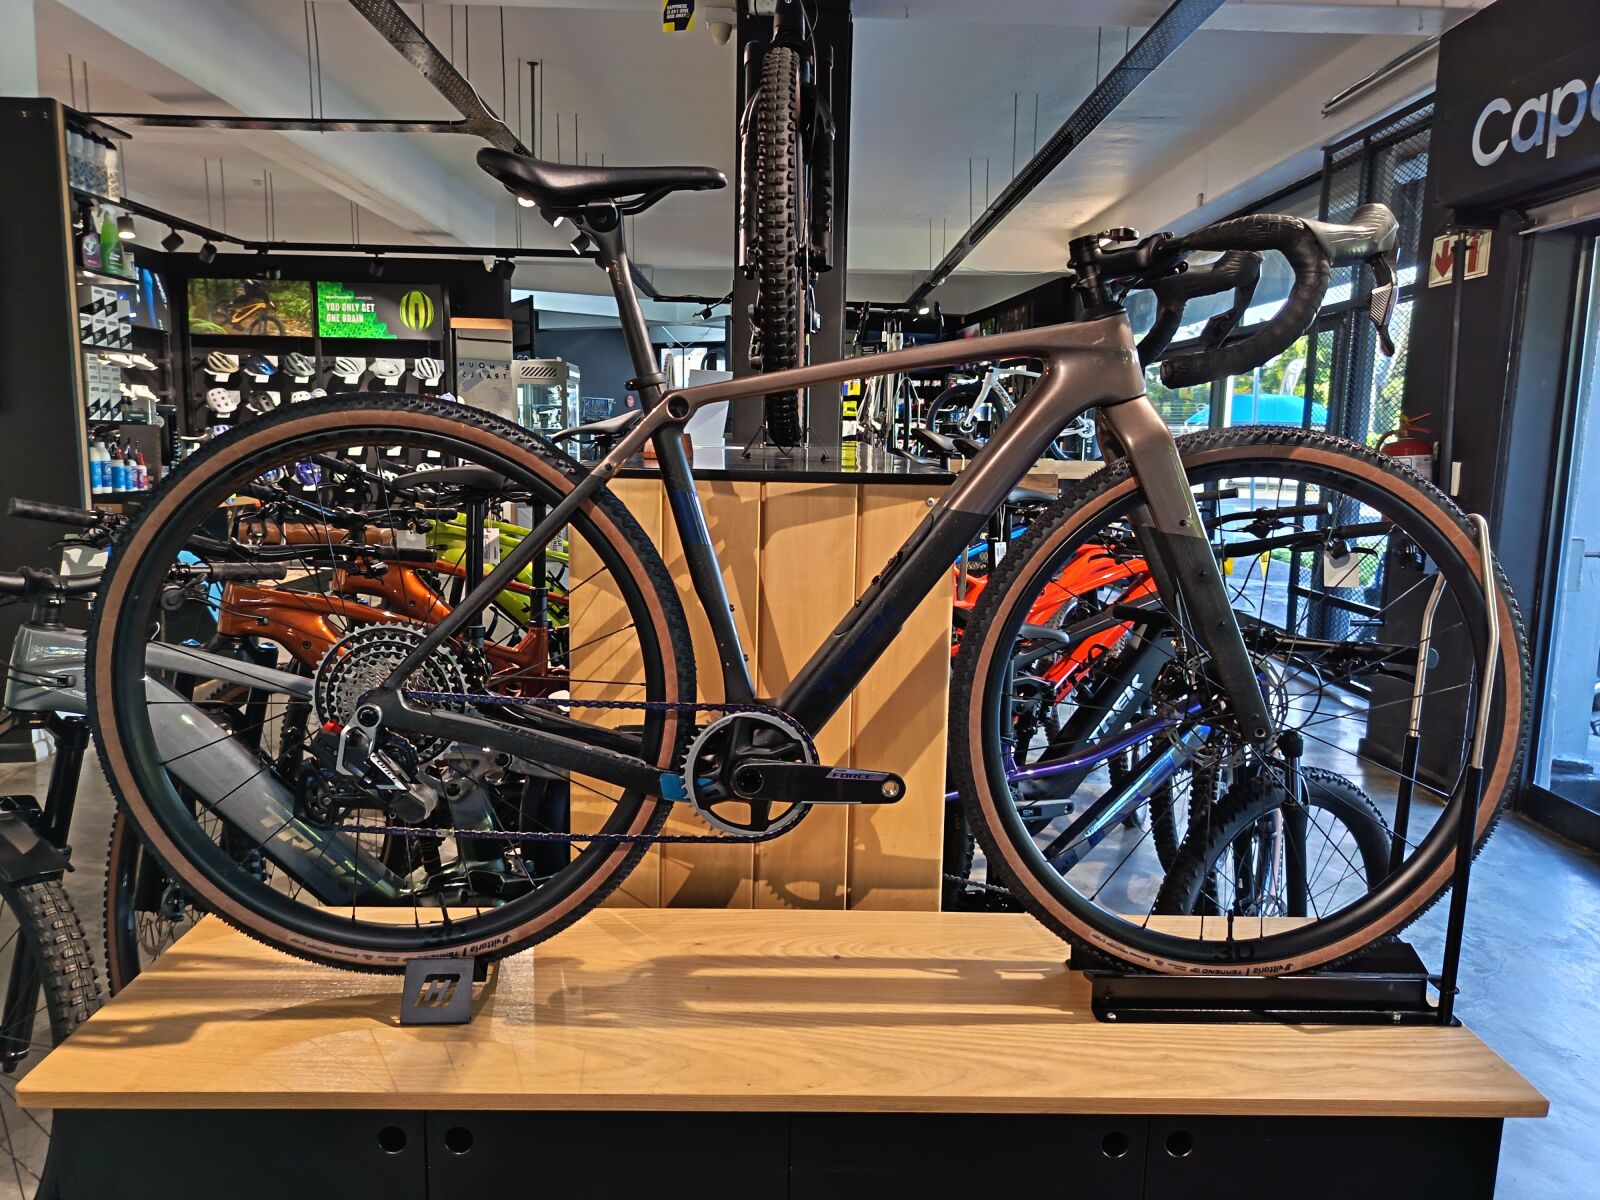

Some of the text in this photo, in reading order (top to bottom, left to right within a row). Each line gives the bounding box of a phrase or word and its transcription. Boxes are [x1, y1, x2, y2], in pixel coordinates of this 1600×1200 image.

[325, 302, 375, 313] YOU ONLY GET
[326, 313, 364, 323] ONE BRAIN
[1086, 673, 1144, 746] TREK
[832, 772, 873, 780] FORCE
[470, 938, 502, 954] vittoria
[1202, 964, 1285, 976] vittoria TERRENO
